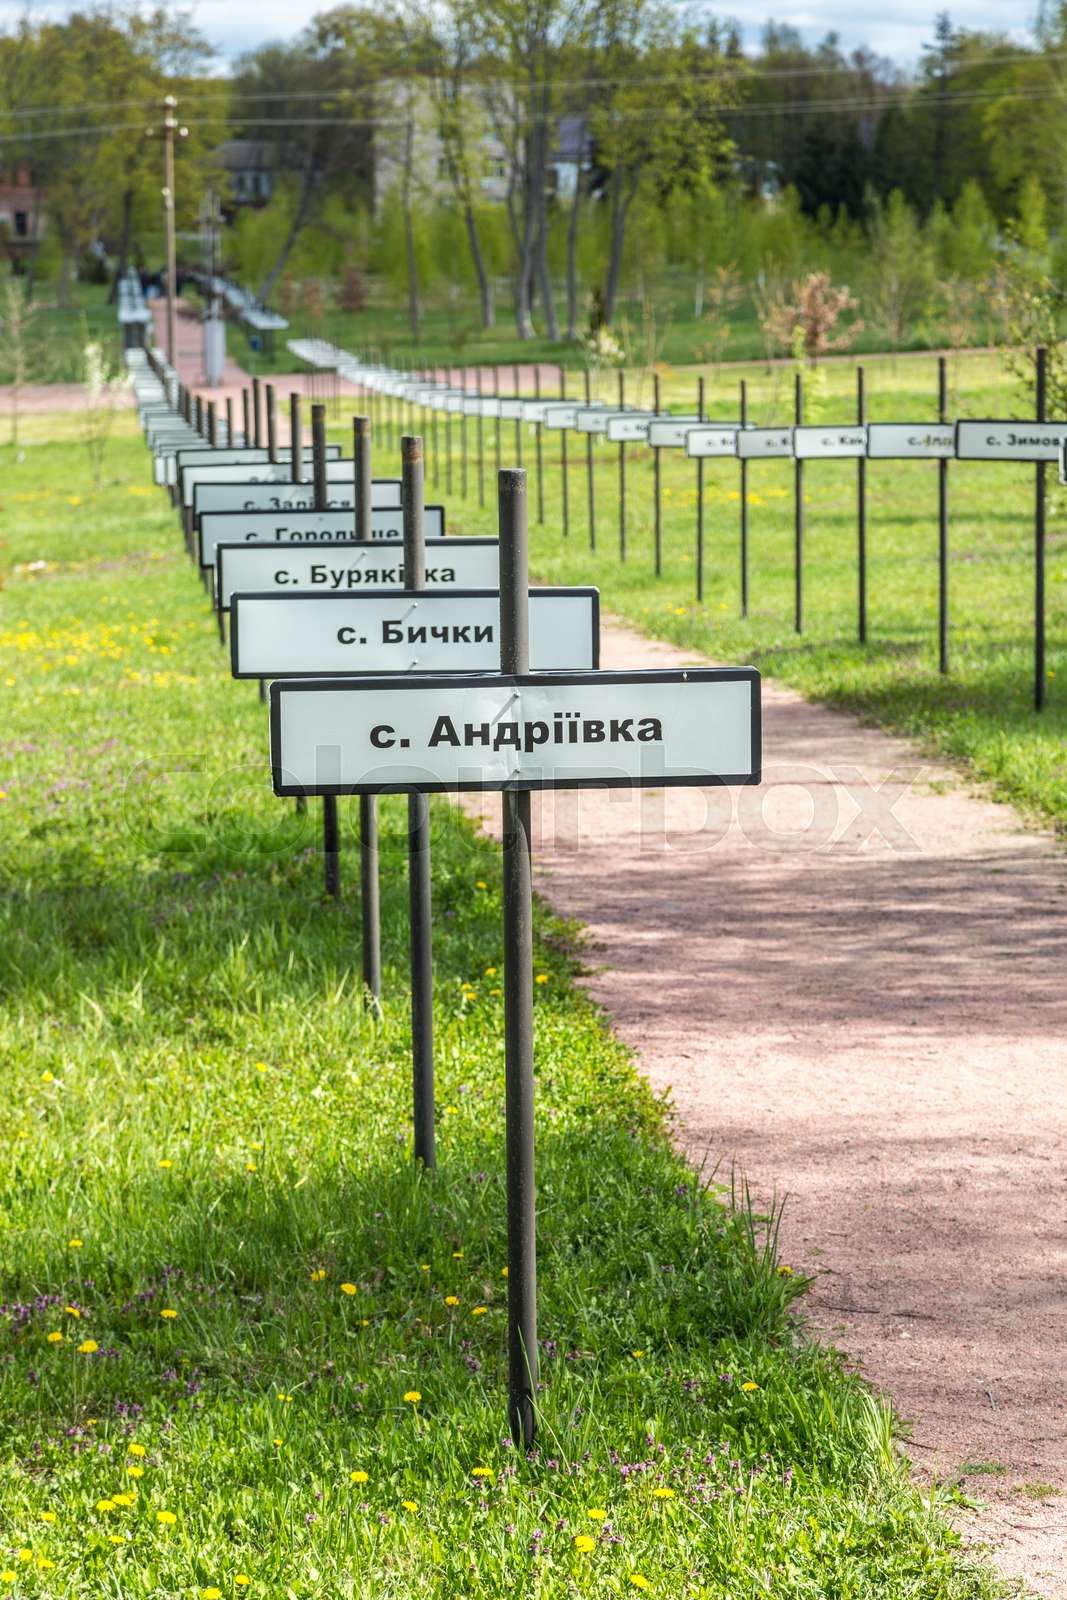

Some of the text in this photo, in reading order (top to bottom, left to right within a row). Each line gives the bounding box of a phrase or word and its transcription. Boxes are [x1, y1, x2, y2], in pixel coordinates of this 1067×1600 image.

[274, 564, 456, 588] с. Бурякіка
[337, 620, 494, 644] с. Бички
[369, 712, 663, 752] с. Андріївка
